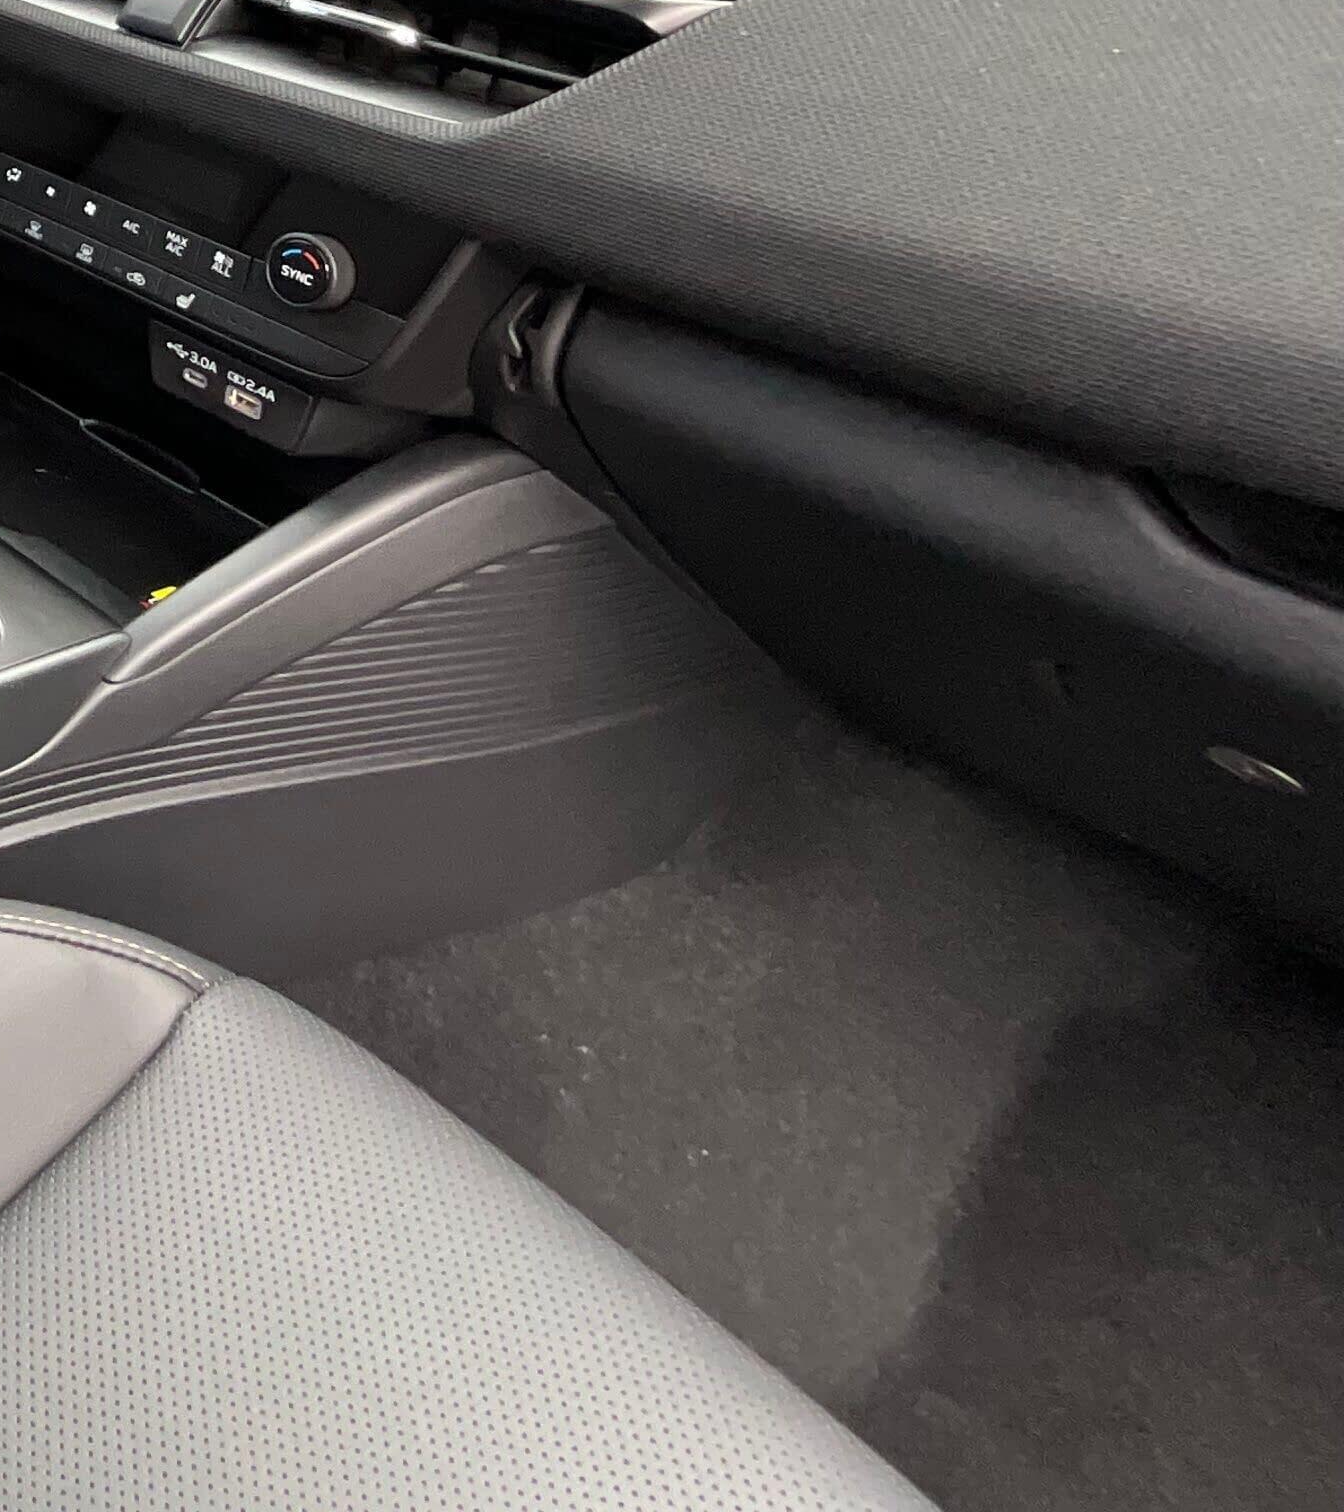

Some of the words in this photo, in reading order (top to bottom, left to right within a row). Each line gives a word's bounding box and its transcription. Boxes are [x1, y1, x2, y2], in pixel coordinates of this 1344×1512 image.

[122, 219, 141, 236] A/C
[165, 230, 189, 248] MAX
[165, 242, 184, 258] A/C
[211, 262, 232, 279] ALL
[280, 264, 314, 287] SYNC
[189, 350, 218, 375] 3.0A
